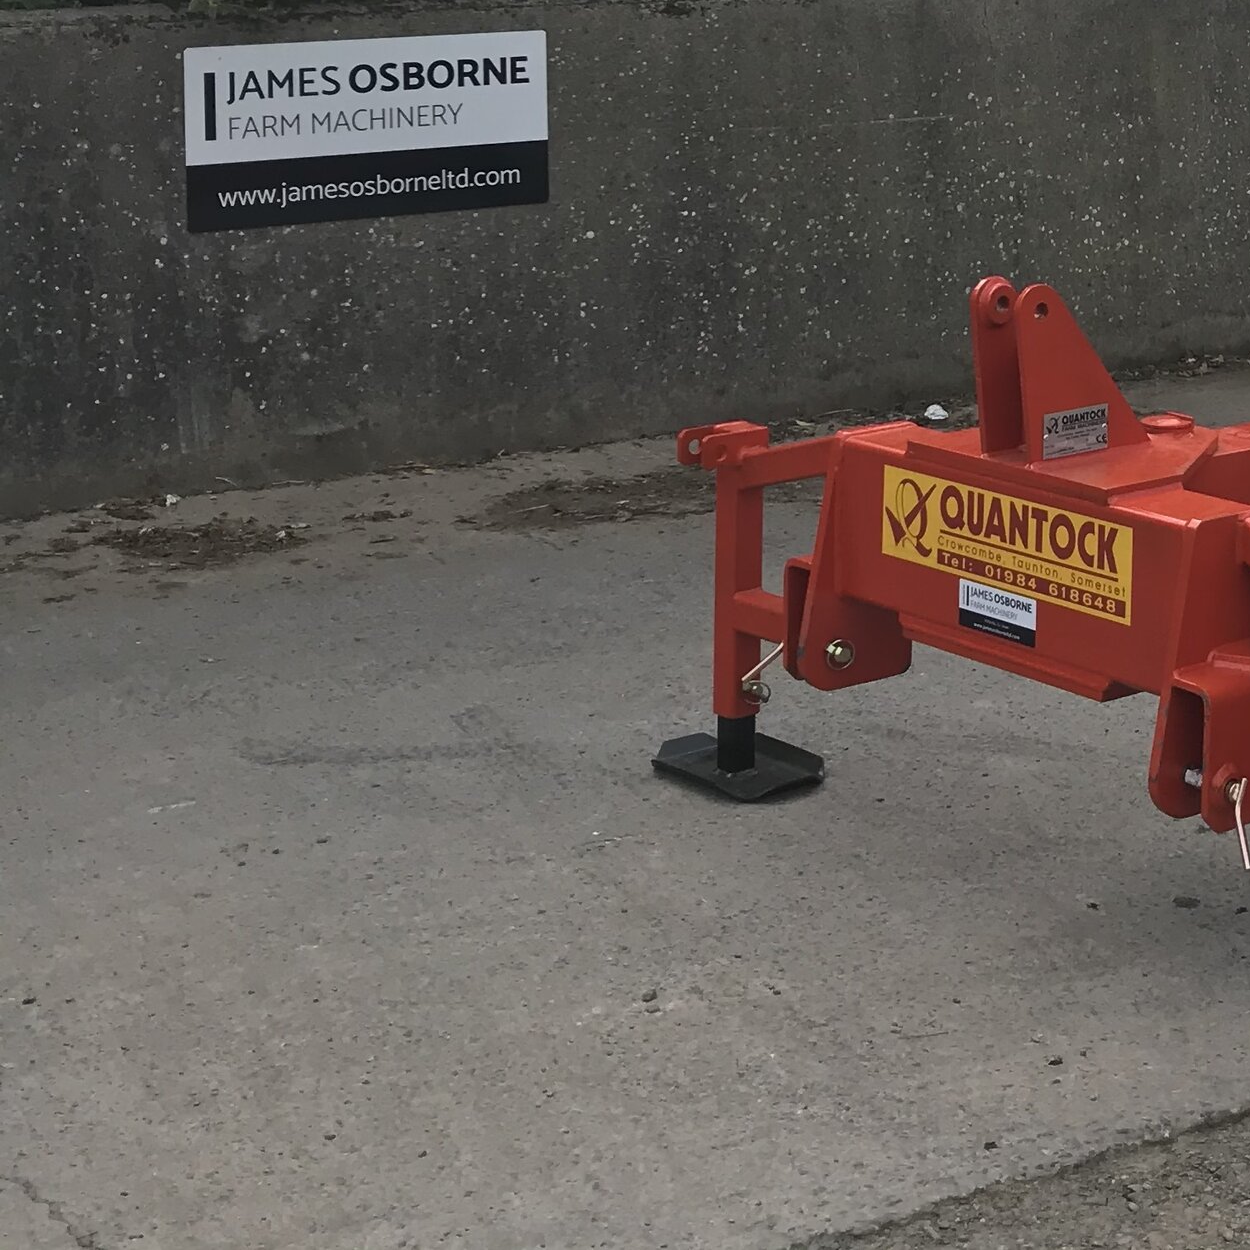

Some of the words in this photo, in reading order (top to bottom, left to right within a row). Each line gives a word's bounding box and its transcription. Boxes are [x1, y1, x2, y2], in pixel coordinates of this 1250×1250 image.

[226, 65, 341, 105] JAMES
[348, 55, 530, 94] OSBORNE
[228, 113, 301, 140] FARM
[311, 102, 464, 135] MACHINERY
[217, 167, 521, 208] www.jamesosborneltd.com
[1061, 408, 1106, 425] QUANTOCK
[940, 485, 1119, 574] QUANTOCK
[942, 552, 973, 572] Tel:
[984, 565, 1037, 591] 01984
[1048, 583, 1117, 613] 618648
[970, 586, 993, 602] JAMES
[994, 593, 1033, 614] OSBORNE
[1070, 572, 1126, 597] Somerset
